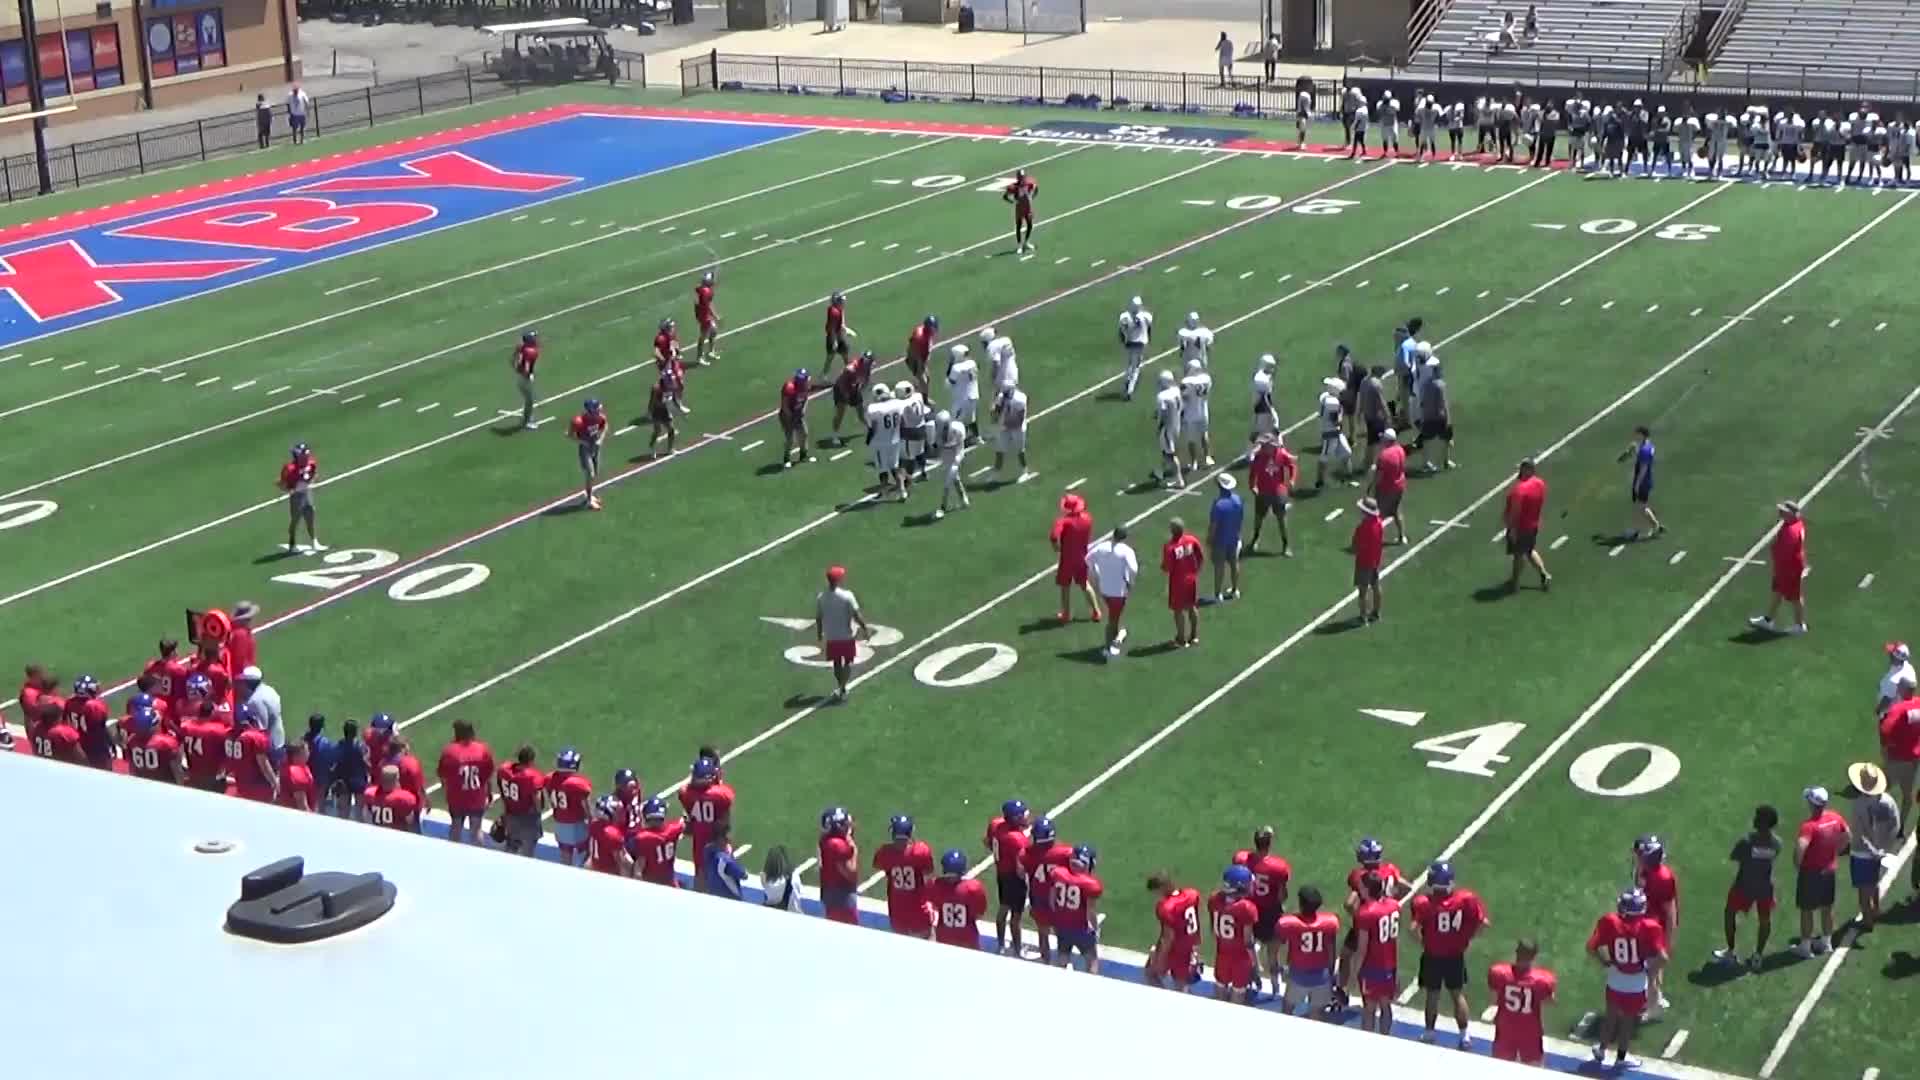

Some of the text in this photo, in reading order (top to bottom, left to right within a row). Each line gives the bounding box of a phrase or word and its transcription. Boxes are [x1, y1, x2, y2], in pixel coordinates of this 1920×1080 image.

[271, 548, 490, 600] 20
[132, 747, 159, 769] 60
[1412, 720, 1681, 796] 40
[371, 805, 394, 824] 70
[690, 800, 715, 822] 40
[891, 866, 915, 890] 33
[1055, 882, 1081, 909] 39
[1213, 910, 1235, 939] 16
[1437, 909, 1462, 932] 84
[1300, 931, 1323, 952] 31
[1614, 937, 1639, 964] 81
[1504, 985, 1532, 1014] 51
